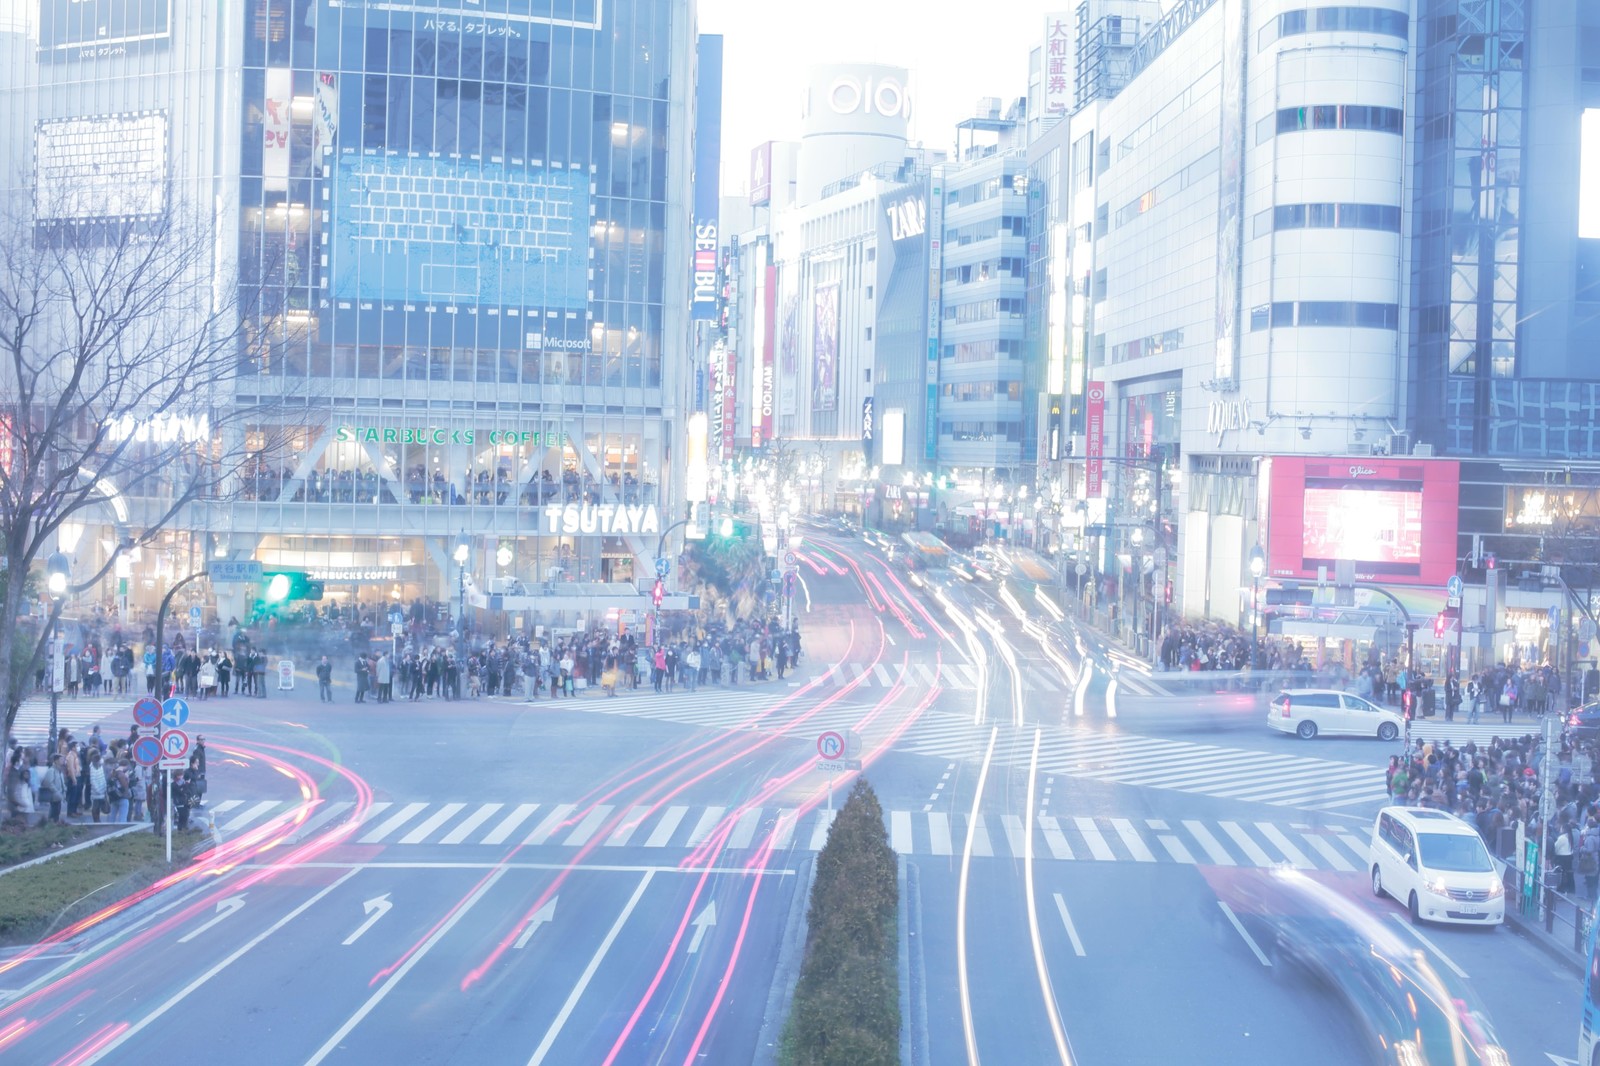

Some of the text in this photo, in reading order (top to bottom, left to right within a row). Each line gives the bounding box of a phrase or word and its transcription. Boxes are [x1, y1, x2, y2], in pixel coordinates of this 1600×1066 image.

[1048, 20, 1069, 95] 大和証券
[694, 219, 717, 302] SEIBU
[544, 337, 591, 349] Microsoft
[863, 403, 873, 440] ZARA
[336, 426, 569, 448] STARBUCKS COFFEE
[1089, 416, 1100, 491] 三菱東京UFJ銀行
[1349, 466, 1377, 478] Glico
[886, 485, 902, 499] ZARA
[545, 503, 658, 533] TSUTAYA
[213, 563, 259, 574] 渋谷駅前
[364, 571, 397, 580] COFFEE
[818, 763, 844, 772] ここから
